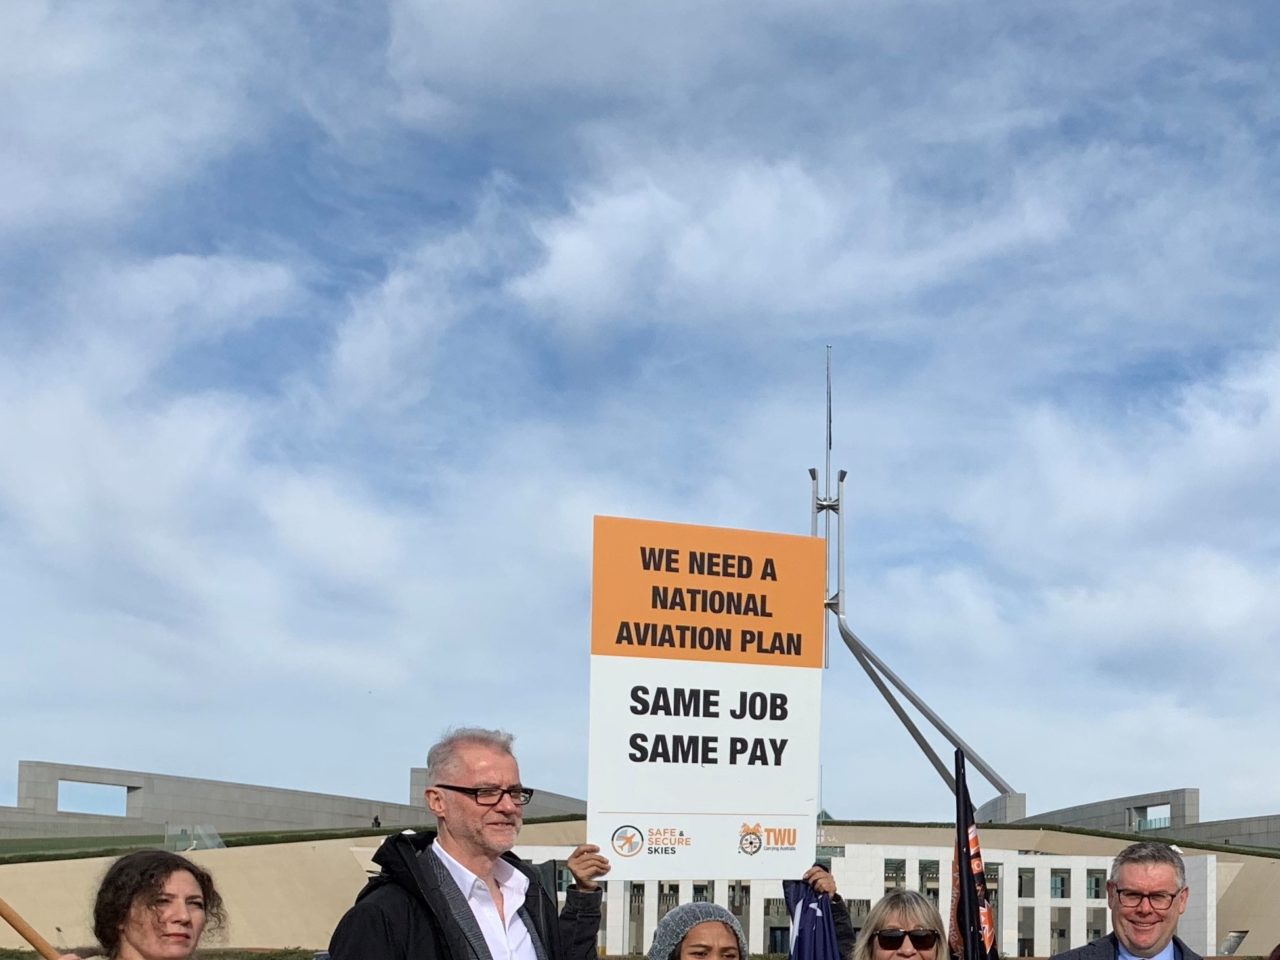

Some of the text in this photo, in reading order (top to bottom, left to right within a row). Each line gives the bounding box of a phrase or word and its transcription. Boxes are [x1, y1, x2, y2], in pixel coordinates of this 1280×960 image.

[640, 546, 778, 582] WE NEED A
[651, 585, 773, 618] NATIONAL
[615, 621, 802, 656] AVIATION PLAN
[629, 685, 789, 721] SAME JOB
[628, 732, 789, 767] SAME PAY
[647, 828, 677, 837] SAFE
[647, 837, 692, 846] SECURE
[764, 827, 797, 846] TWU
[647, 846, 677, 855] SKIES
